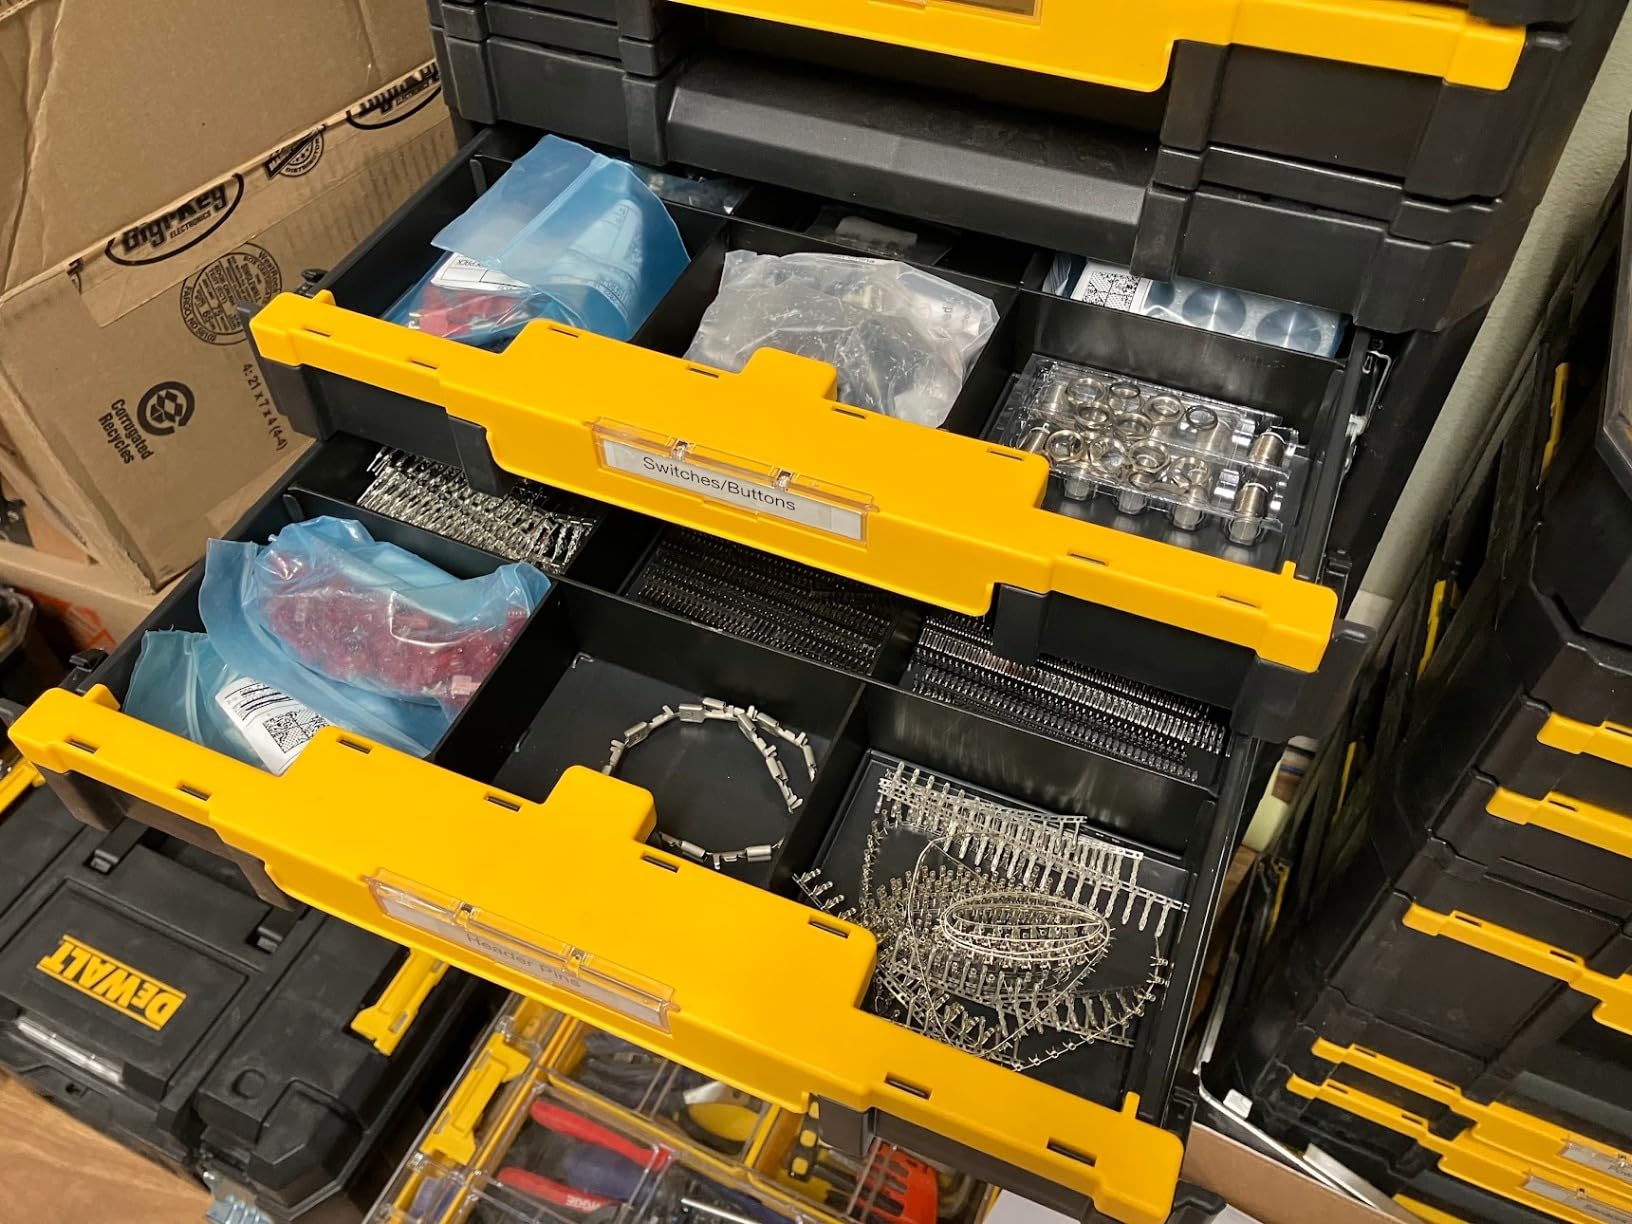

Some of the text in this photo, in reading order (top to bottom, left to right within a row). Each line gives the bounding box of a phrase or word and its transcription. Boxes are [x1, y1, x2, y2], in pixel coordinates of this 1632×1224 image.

[170, 210, 212, 239] ELECTRONICS
[247, 375, 261, 390] 21
[259, 398, 270, 407] 7
[268, 417, 277, 426] 4
[98, 412, 134, 464] Recycles
[111, 399, 154, 460] Corrugated
[643, 456, 796, 511] Switches/Buttons
[36, 938, 185, 1029] DEWALT
[465, 933, 581, 988] Header Pins
